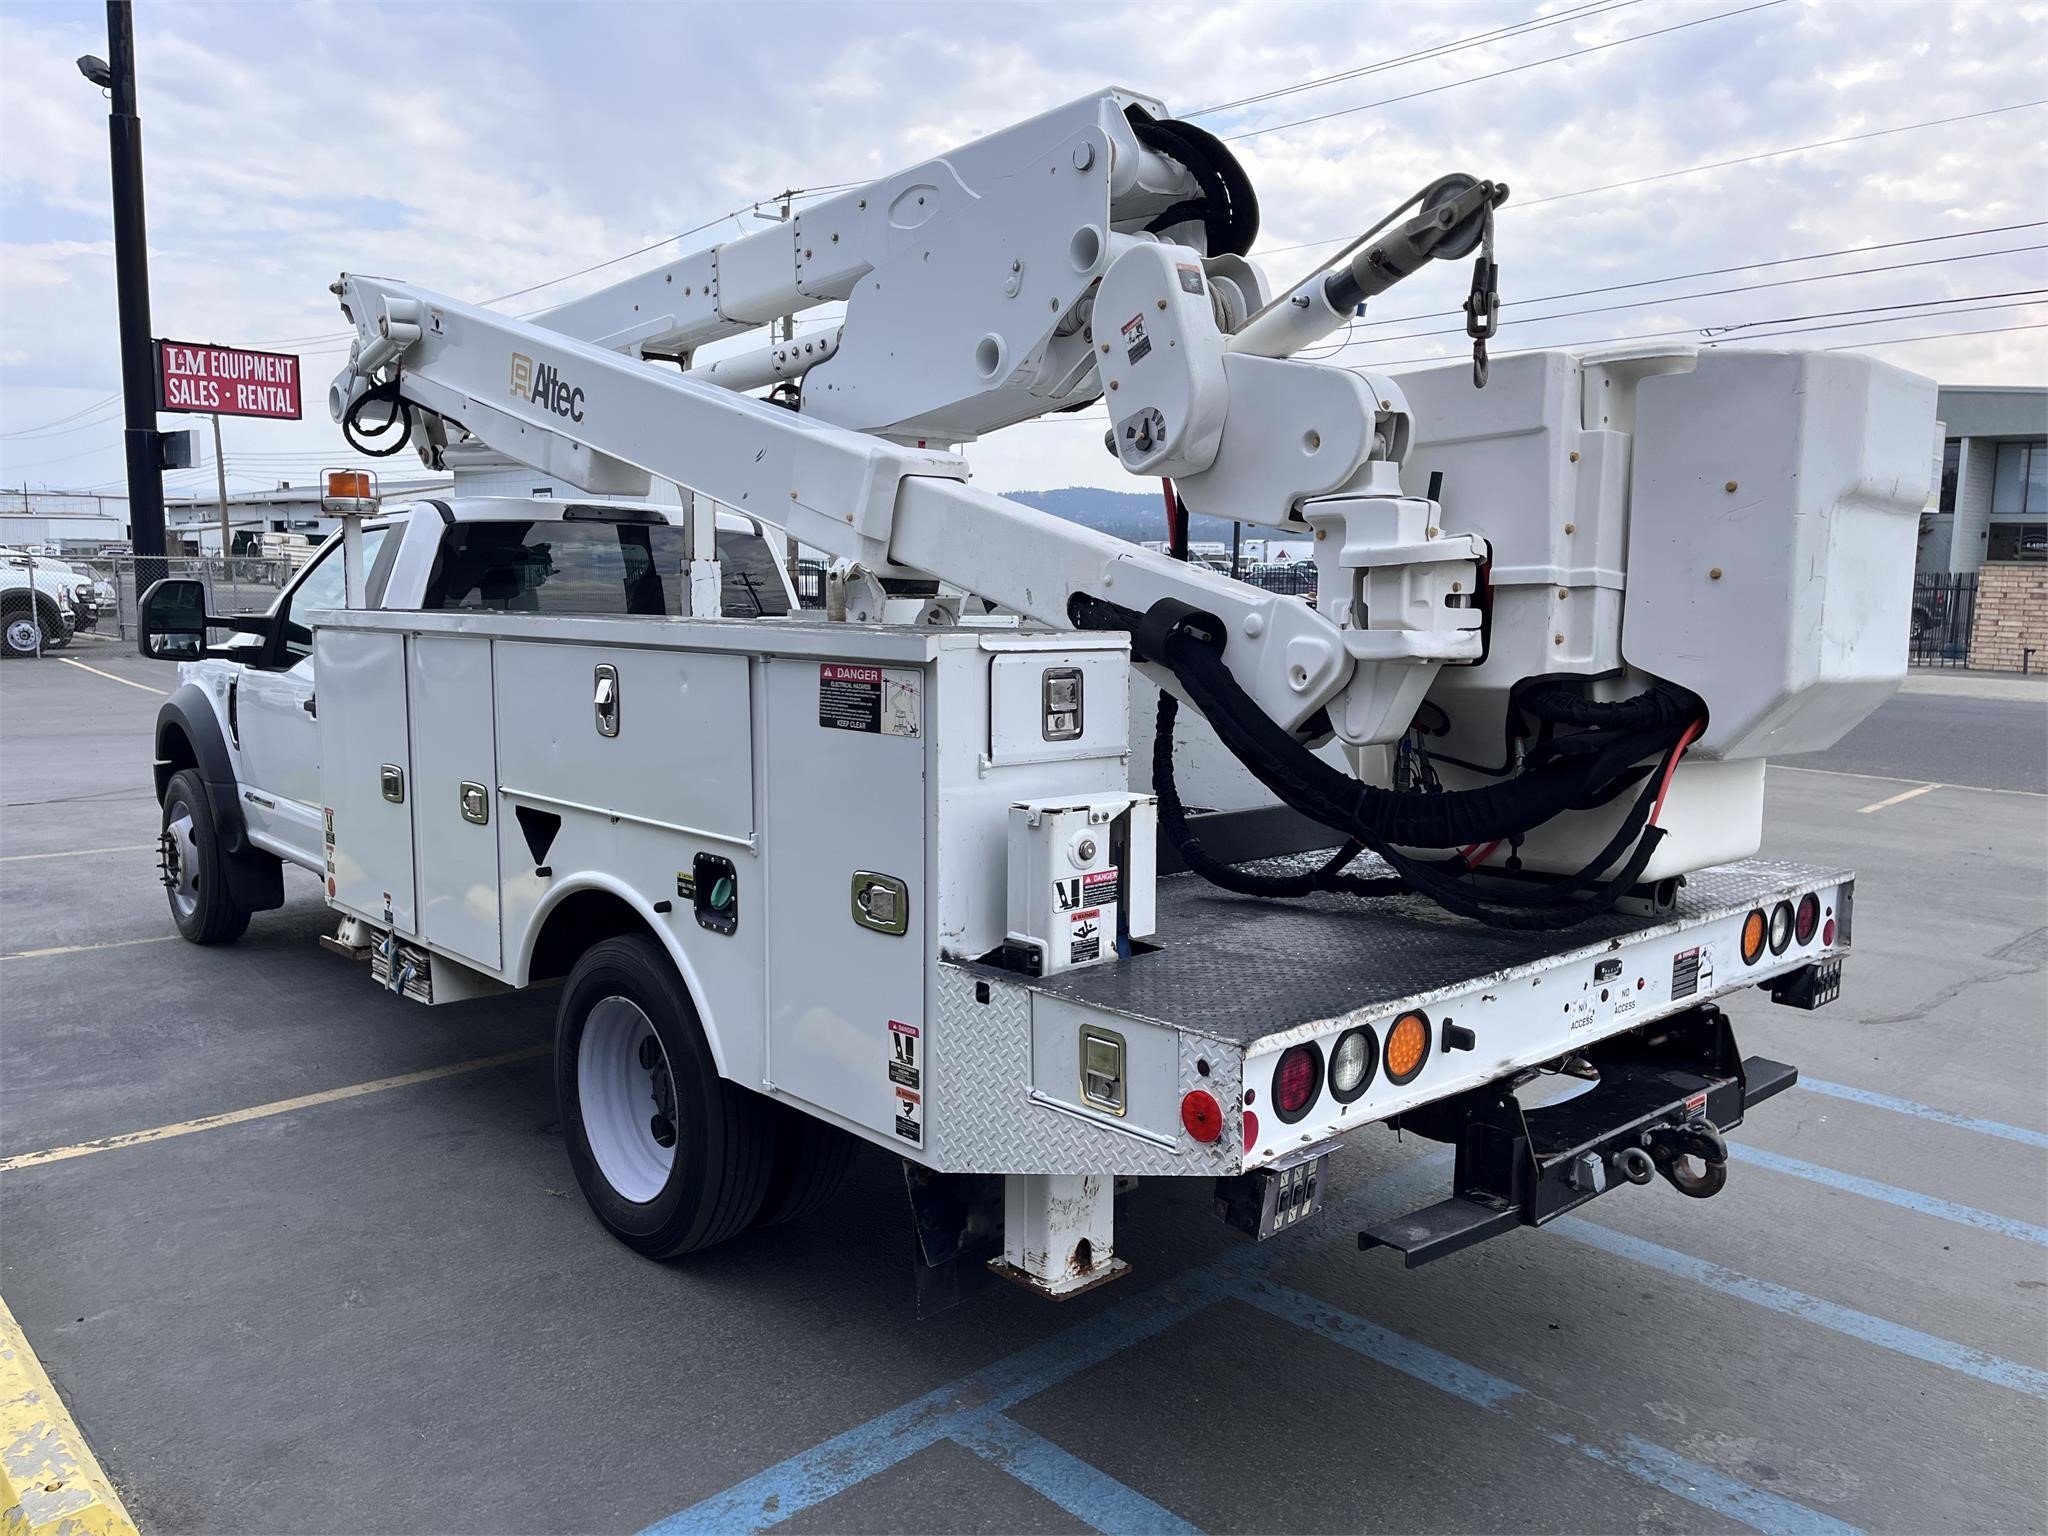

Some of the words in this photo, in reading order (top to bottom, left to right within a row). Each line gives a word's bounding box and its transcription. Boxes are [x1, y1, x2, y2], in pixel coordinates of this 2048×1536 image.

[166, 347, 207, 376] L&M
[211, 351, 292, 384] EQUIPMENT
[169, 377, 220, 407] SALES
[237, 384, 294, 413] RENTAL
[531, 362, 585, 422] Altec
[837, 667, 878, 681] DANGER
[837, 720, 850, 728] KEEP
[850, 721, 866, 729] CLEAR
[1093, 871, 1118, 882] DANGER
[1622, 988, 1630, 997] NO
[1614, 1000, 1636, 1014] ACCESS
[1571, 1015, 1593, 1031] ACCESS
